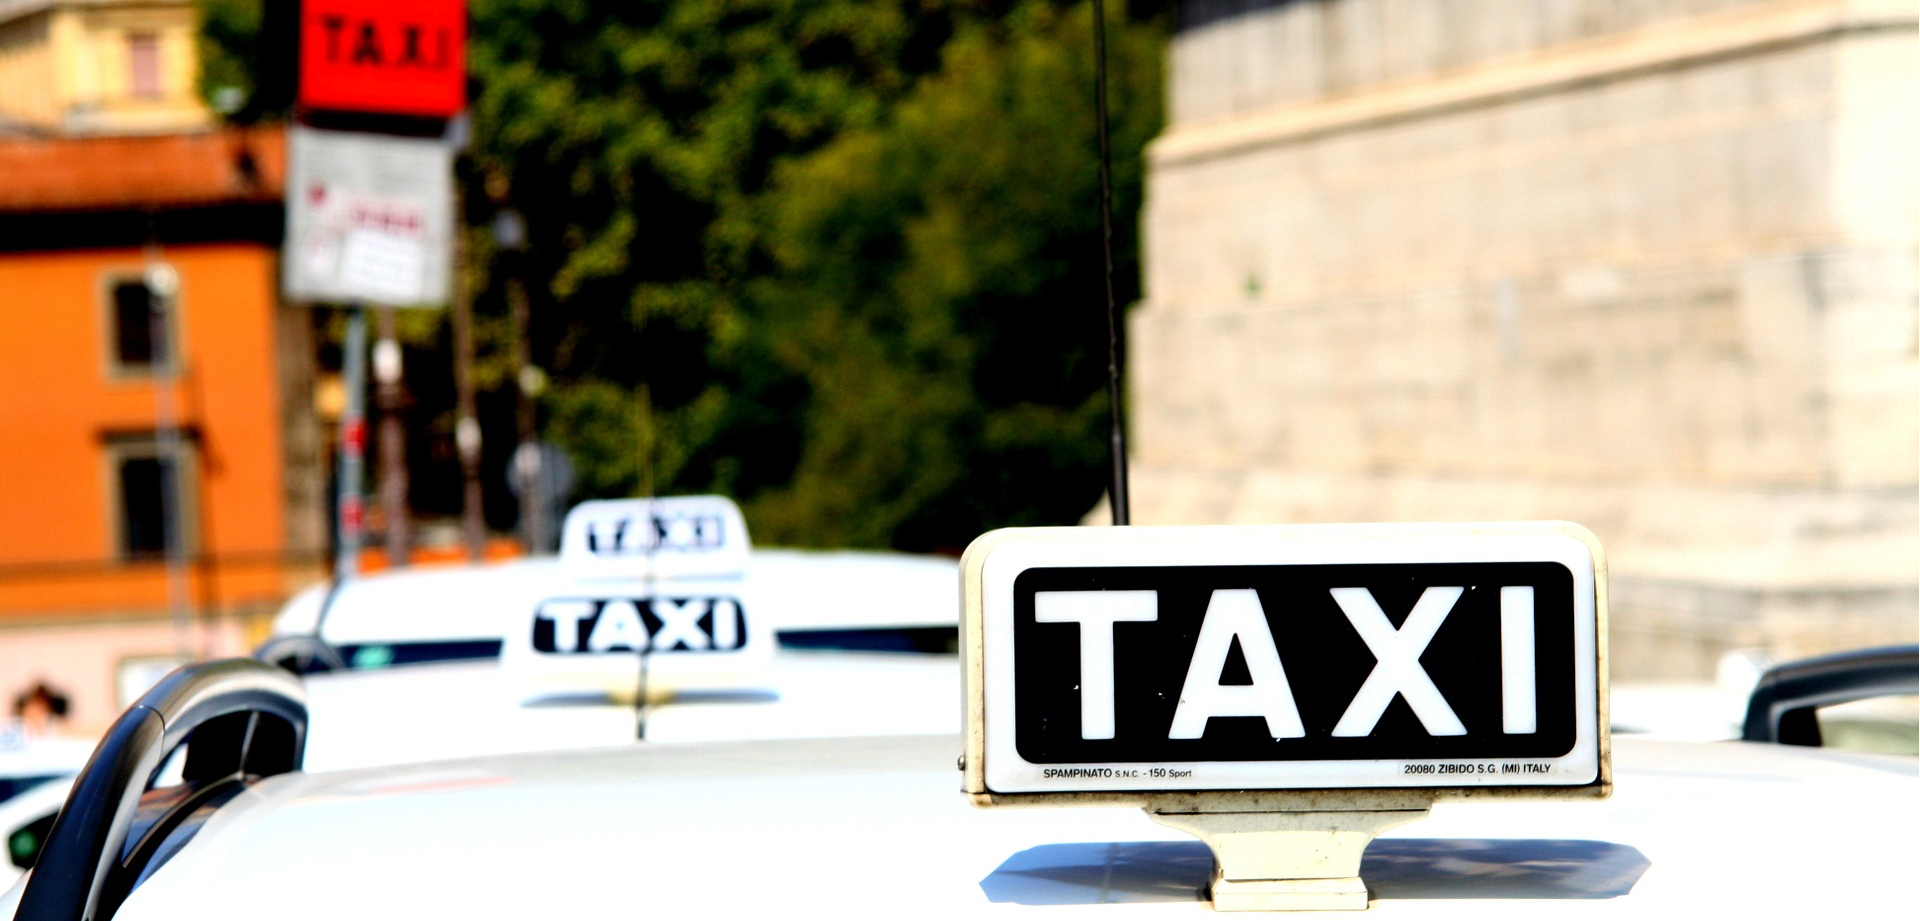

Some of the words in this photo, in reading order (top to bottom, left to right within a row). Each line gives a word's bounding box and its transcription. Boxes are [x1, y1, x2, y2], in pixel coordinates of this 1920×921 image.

[321, 14, 450, 71] TAXI
[539, 600, 738, 652] TAXI
[1035, 586, 1536, 740] TAXI
[1043, 768, 1113, 779] SPAMPINATO
[1115, 769, 1140, 778] S.N.C.
[1149, 768, 1167, 778] 150
[1168, 769, 1192, 779] Sport
[1404, 764, 1436, 774] 20080
[1438, 764, 1475, 774] ZIBIDO
[1477, 763, 1499, 774] S.G.
[1501, 763, 1521, 774] (MI)
[1523, 763, 1552, 773] ITALY
